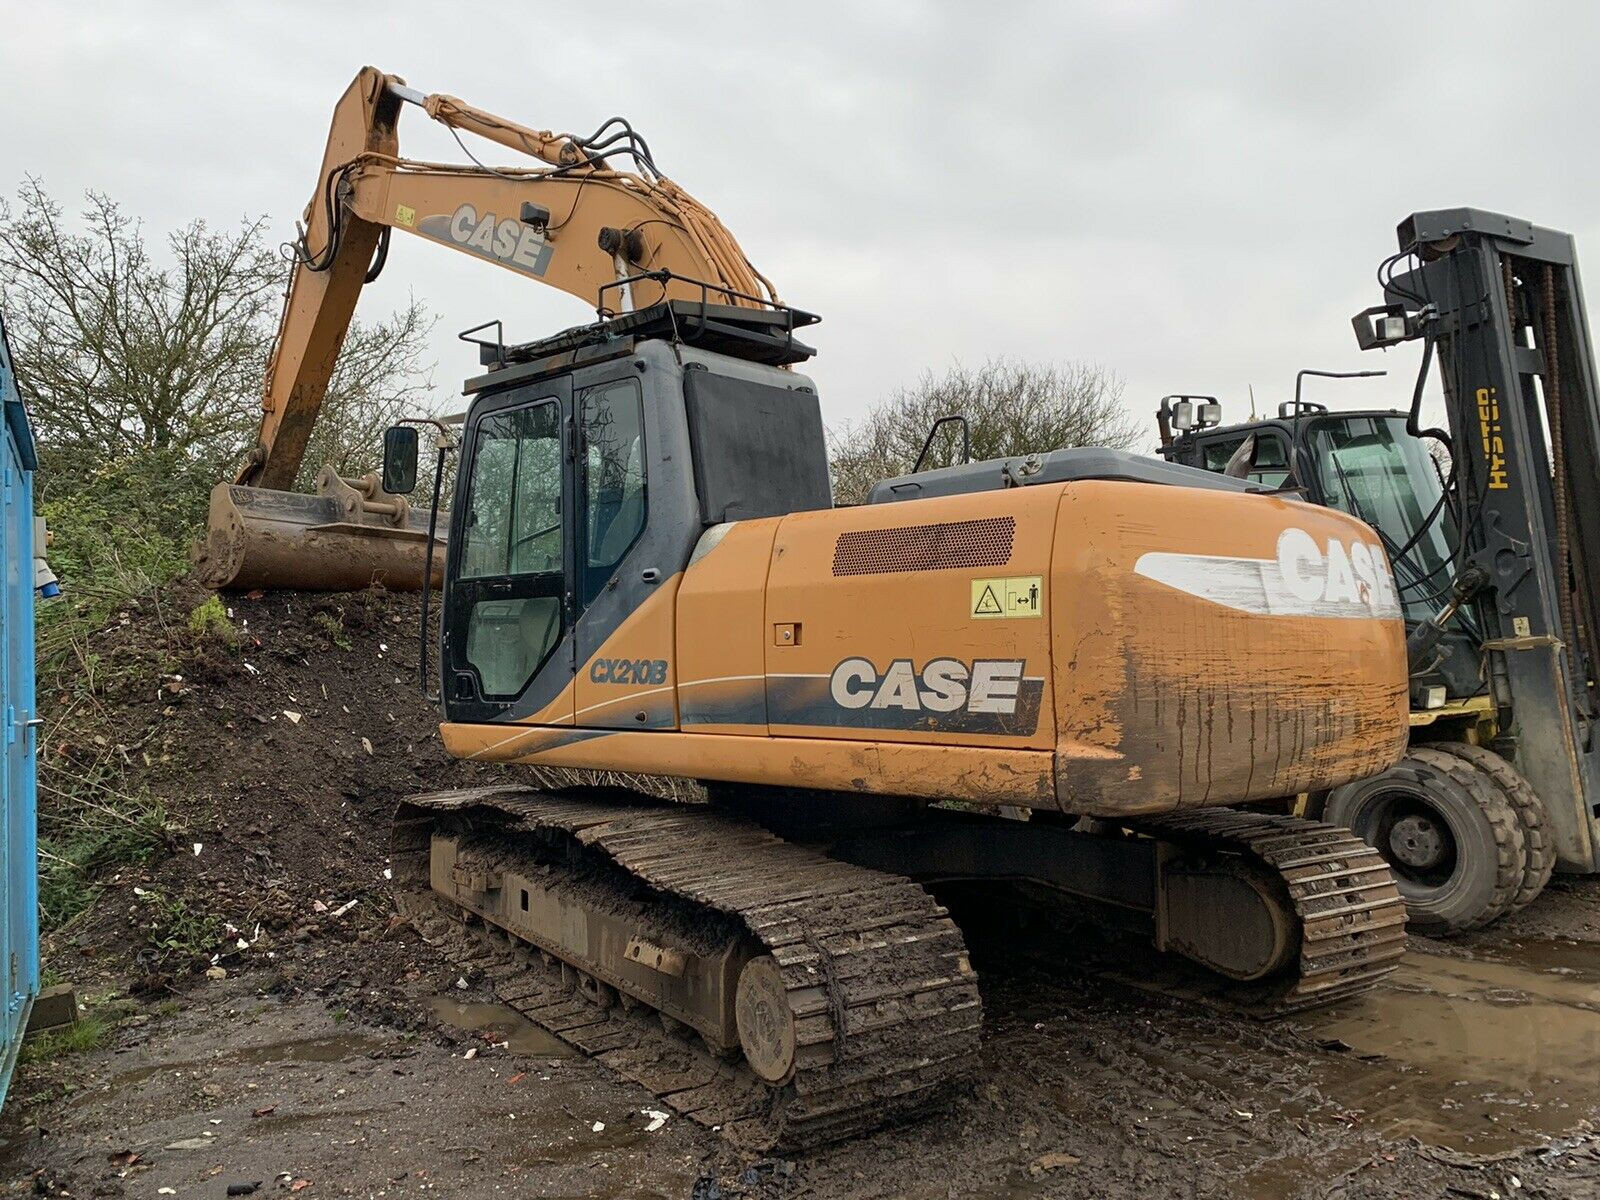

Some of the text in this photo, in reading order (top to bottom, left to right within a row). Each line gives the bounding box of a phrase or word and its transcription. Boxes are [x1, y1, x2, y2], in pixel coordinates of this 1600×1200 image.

[450, 203, 546, 269] CASE
[1476, 387, 1508, 489] HYSTER
[1276, 527, 1394, 604] CASE
[590, 658, 668, 685] CX210B
[830, 658, 1024, 714] CASE
